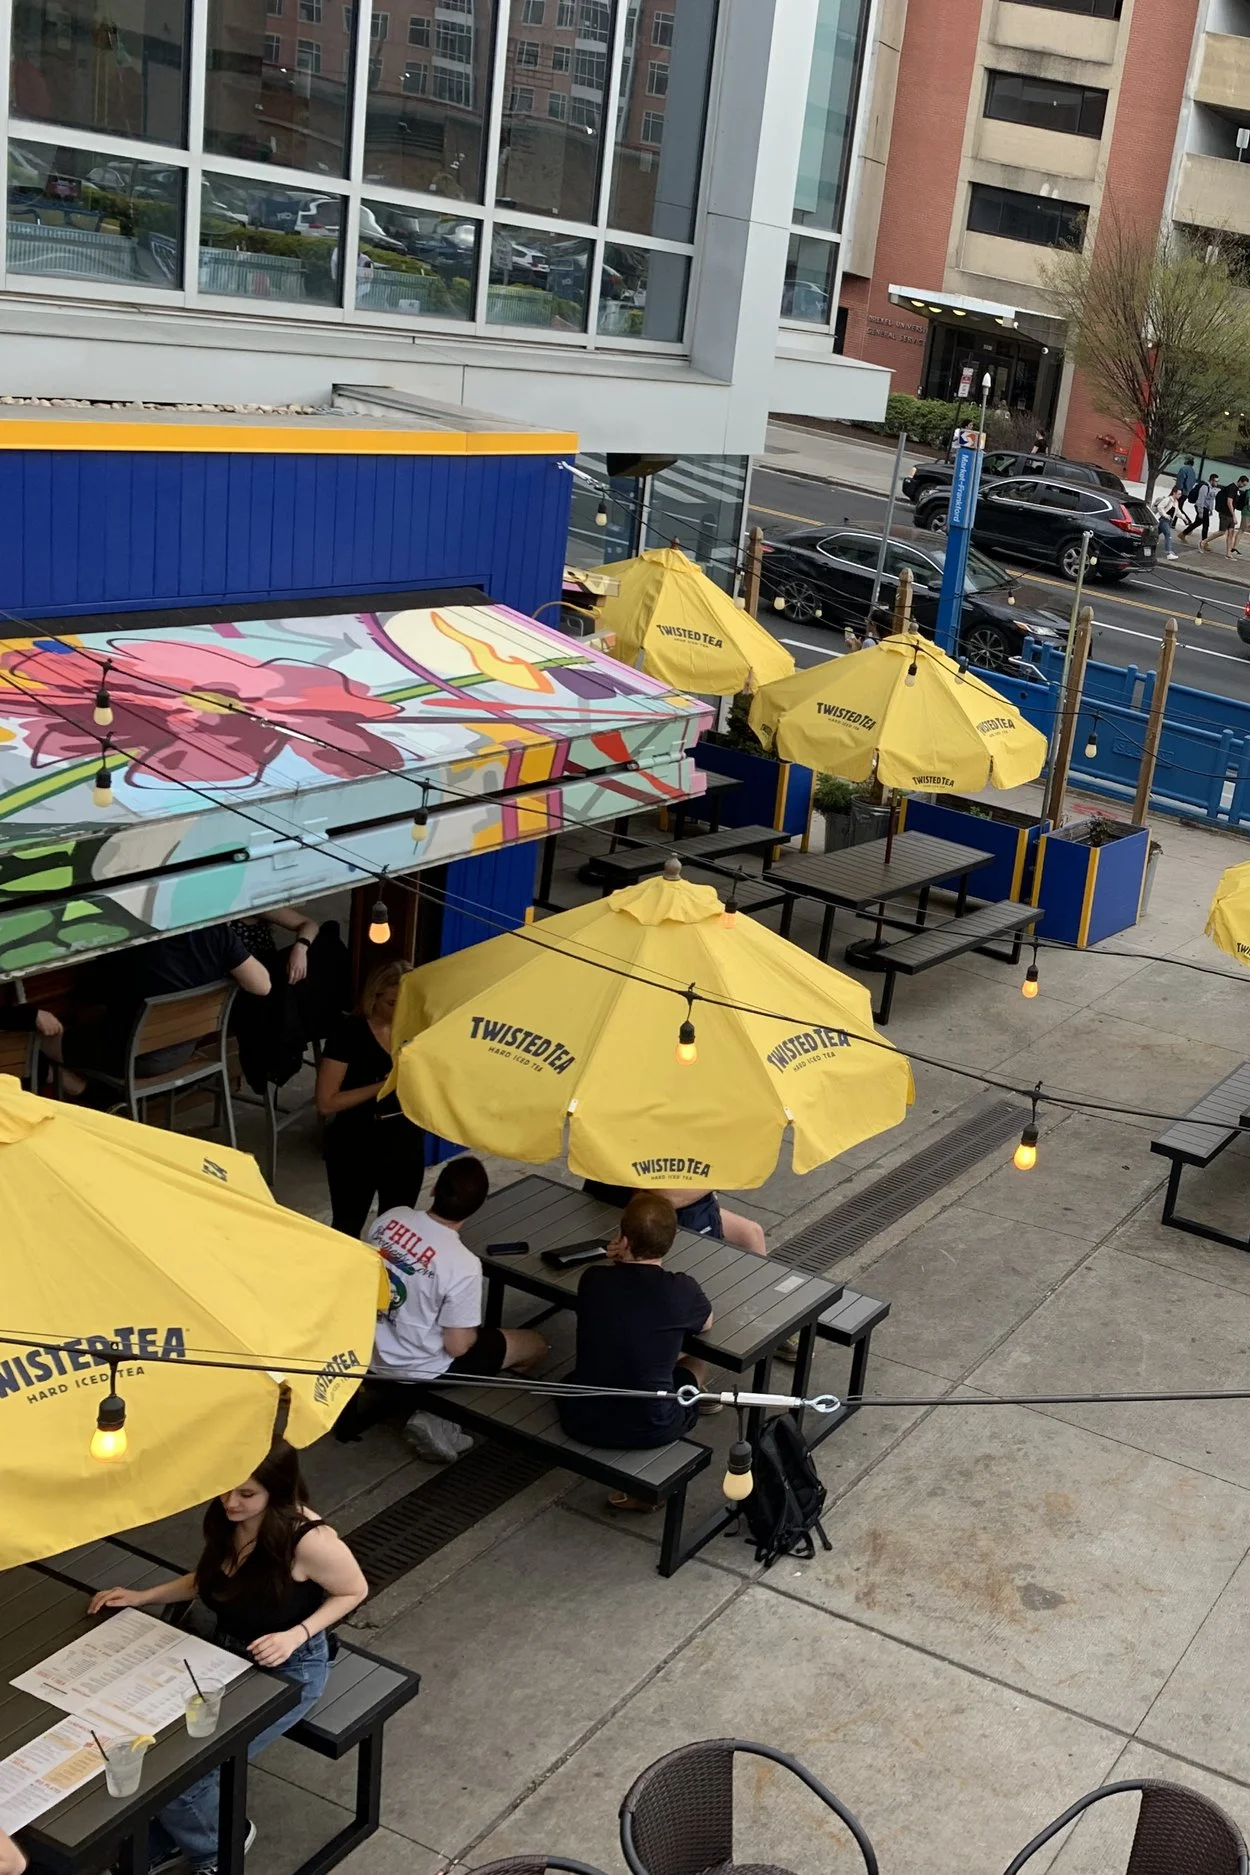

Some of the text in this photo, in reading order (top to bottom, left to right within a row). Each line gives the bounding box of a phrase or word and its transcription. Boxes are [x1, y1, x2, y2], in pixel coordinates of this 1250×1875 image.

[953, 453, 970, 523] Market-Frankford
[656, 624, 701, 641] TWISTED
[702, 633, 723, 648] TEA
[816, 702, 877, 731] TWISTED TEA
[995, 717, 1016, 729] TEA
[912, 775, 941, 785] TWISTED
[941, 777, 955, 787] TEA
[470, 1016, 576, 1075] TWISTED TEA
[488, 1046, 543, 1072] HARD ICED TEA
[767, 1028, 851, 1074] TWISTED TEA
[822, 1051, 836, 1059] TEA
[632, 1157, 711, 1178] TWISTED TEA
[382, 1219, 436, 1269] PHILA
[0, 1326, 186, 1399] WISTED TEA
[27, 1366, 145, 1404] HARD ICED TEA
